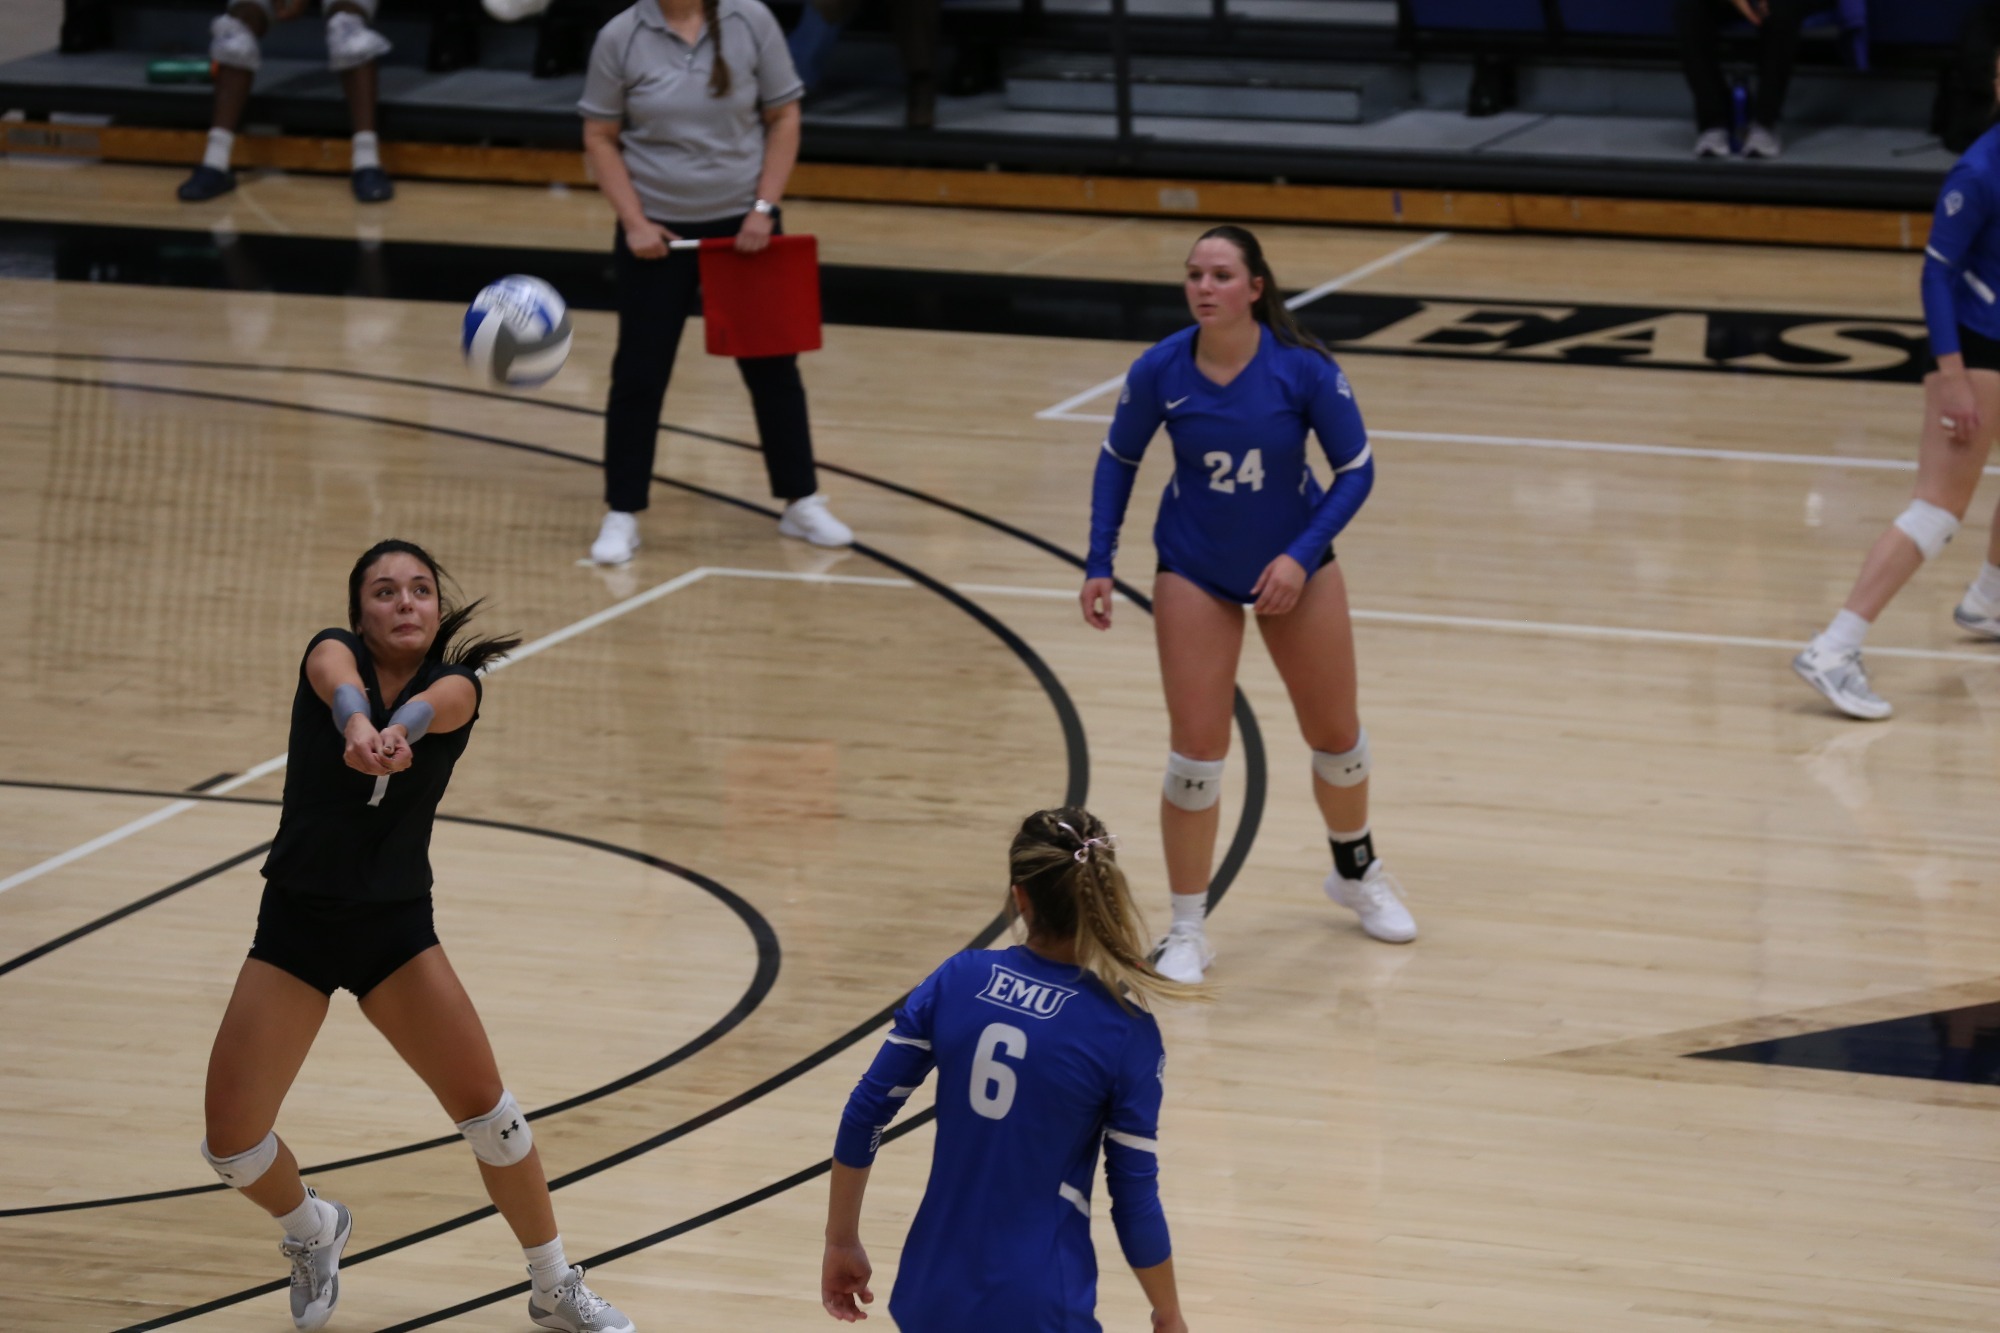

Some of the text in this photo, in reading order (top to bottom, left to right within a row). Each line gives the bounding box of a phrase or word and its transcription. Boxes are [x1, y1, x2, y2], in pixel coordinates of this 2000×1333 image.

[1328, 303, 1929, 373] EAS
[1203, 448, 1265, 494] 24
[987, 971, 1065, 1014] EMU
[969, 1022, 1027, 1120] 6
